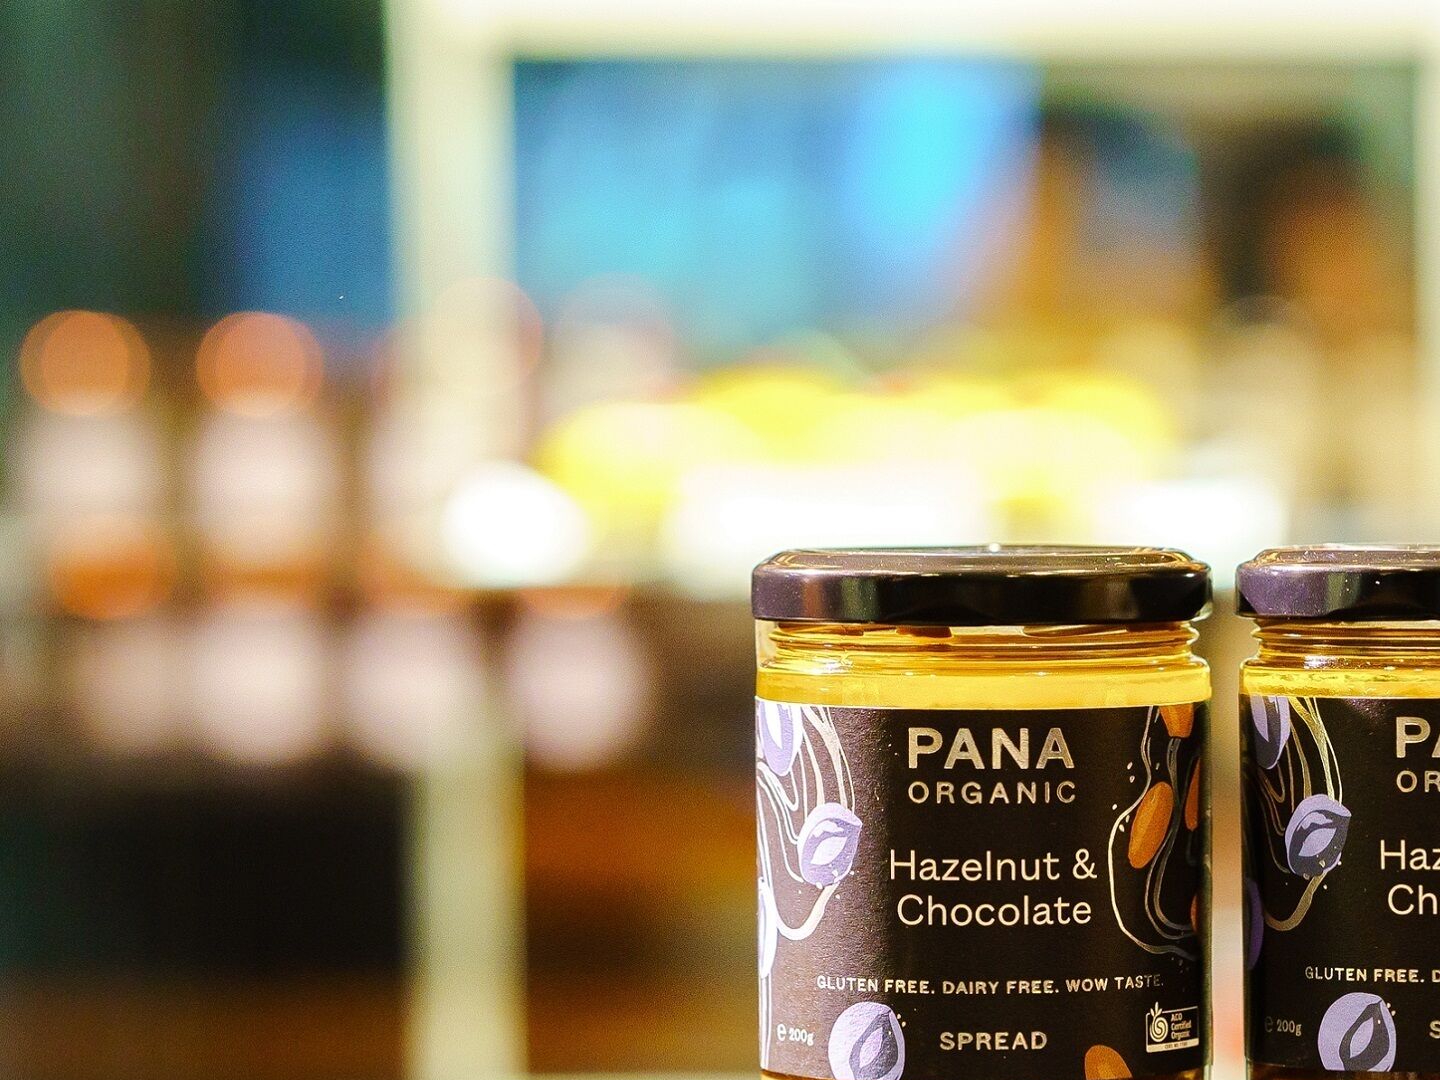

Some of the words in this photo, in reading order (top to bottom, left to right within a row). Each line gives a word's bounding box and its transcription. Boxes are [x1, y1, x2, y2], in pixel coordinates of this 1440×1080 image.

[908, 727, 1075, 770] PANA
[908, 781, 1076, 804] ORGANIC
[890, 849, 1060, 882] Hazelnut
[1072, 849, 1097, 879] &
[897, 894, 1092, 926] Chocolate
[1305, 966, 1367, 982] GLUTEN
[1374, 968, 1424, 983] FREE.
[817, 975, 878, 992] GLUTEN
[884, 978, 935, 994] FREE.
[943, 981, 998, 995] DAIRY
[1007, 980, 1059, 995] FREE.
[1065, 977, 1109, 992] WOW
[1276, 1018, 1302, 1036] 200g
[789, 1029, 814, 1046] 200g
[940, 1031, 1048, 1051] SPREAD
